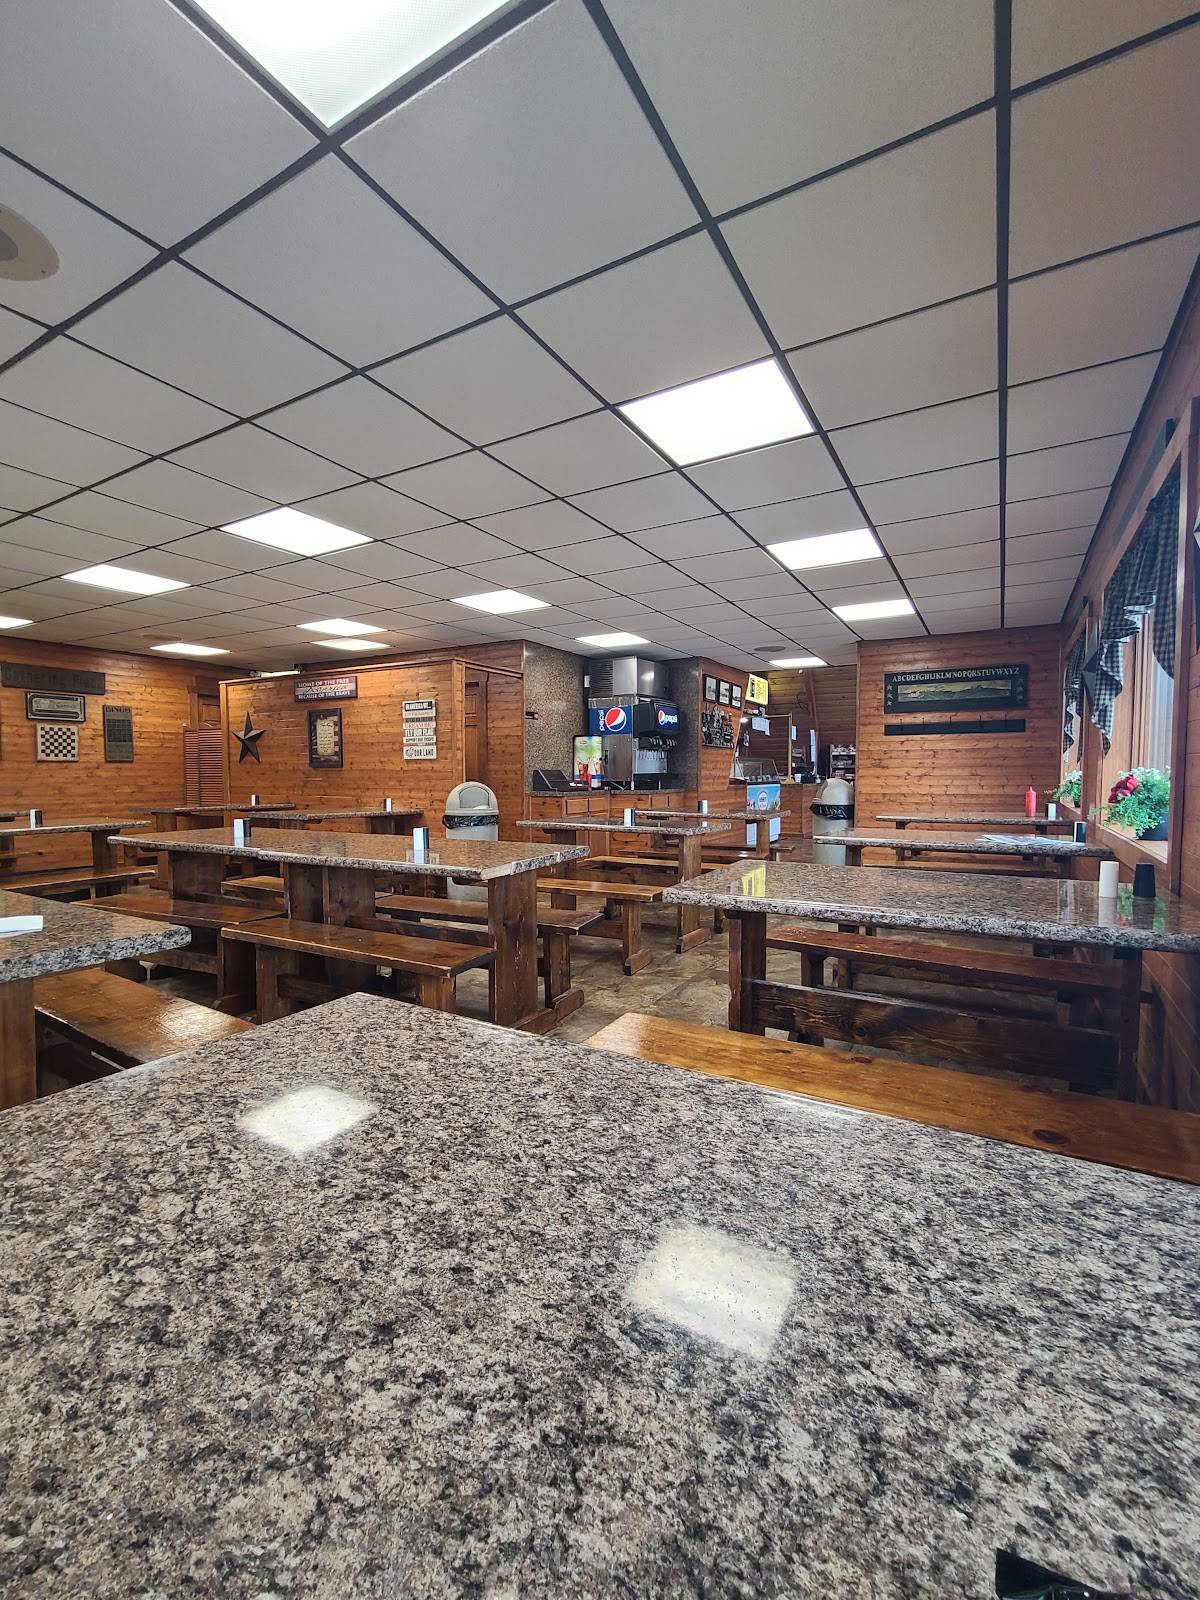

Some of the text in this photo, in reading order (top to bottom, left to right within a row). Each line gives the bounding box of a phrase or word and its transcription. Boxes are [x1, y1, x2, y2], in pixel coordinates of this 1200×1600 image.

[664, 715, 677, 723] pepsi
[405, 729, 414, 737] FLY
[414, 728, 424, 736] OUR
[414, 748, 434, 757] OUR LAND
